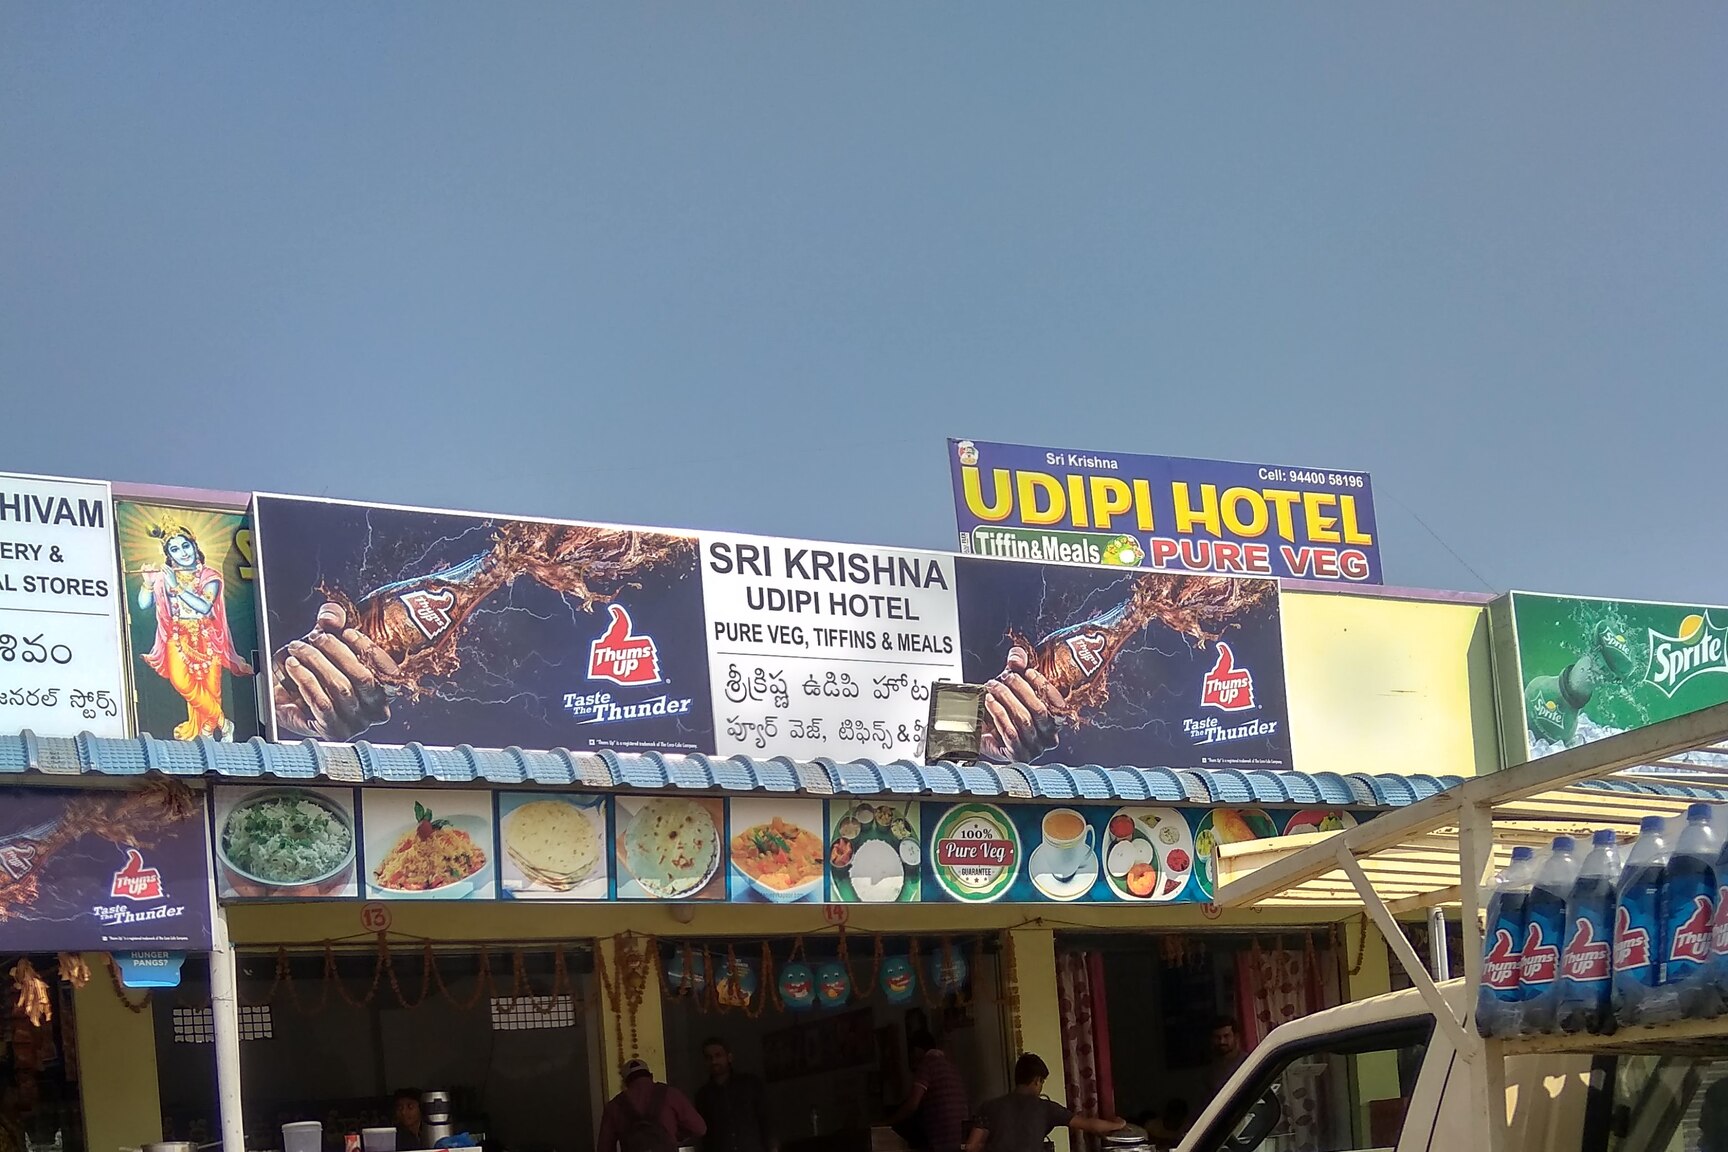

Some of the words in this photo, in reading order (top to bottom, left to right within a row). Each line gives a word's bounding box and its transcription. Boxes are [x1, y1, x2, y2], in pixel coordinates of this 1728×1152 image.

[1046, 453, 1065, 466] Sri
[1069, 454, 1118, 469] Krishna
[1258, 467, 1286, 482] Cell:
[1290, 469, 1325, 485] 94400
[1328, 473, 1363, 488] 58196
[962, 466, 1155, 531] UDIPI
[1171, 481, 1373, 546] HOTEL
[49, 545, 64, 563] &
[1150, 538, 1271, 575] PURE
[1281, 545, 1369, 580] VEG
[709, 542, 772, 576] SRI
[784, 547, 948, 590] KRISHNA
[0, 574, 17, 592] L
[23, 575, 108, 597] STORES
[746, 586, 820, 614] UDIPI
[829, 592, 920, 621] HOTEL
[714, 621, 762, 643] PURE
[767, 625, 809, 649] VEG,
[813, 628, 876, 650] TIFFINS
[881, 632, 893, 651] &
[897, 633, 953, 654] MEALS
[1603, 631, 1630, 655] Sprite
[595, 646, 651, 667] Thums
[1654, 627, 1722, 686] Sprite
[873, 673, 950, 701] హోట
[1207, 677, 1248, 695] Thums
[563, 692, 611, 708] Taste
[573, 706, 592, 715] The
[590, 695, 691, 723] Thunder
[1534, 699, 1562, 723] Sprite
[1183, 717, 1218, 732] Taste
[1191, 730, 1204, 738] The
[1204, 719, 1278, 743] Thunder
[960, 828, 993, 839] 100%
[945, 842, 978, 858] Pure
[980, 842, 1006, 863] Veg
[961, 868, 992, 876] GUARANTEE
[93, 905, 127, 916] Taste
[113, 905, 185, 924] Thunder
[363, 908, 386, 927] 13
[131, 951, 169, 959] HUNGER
